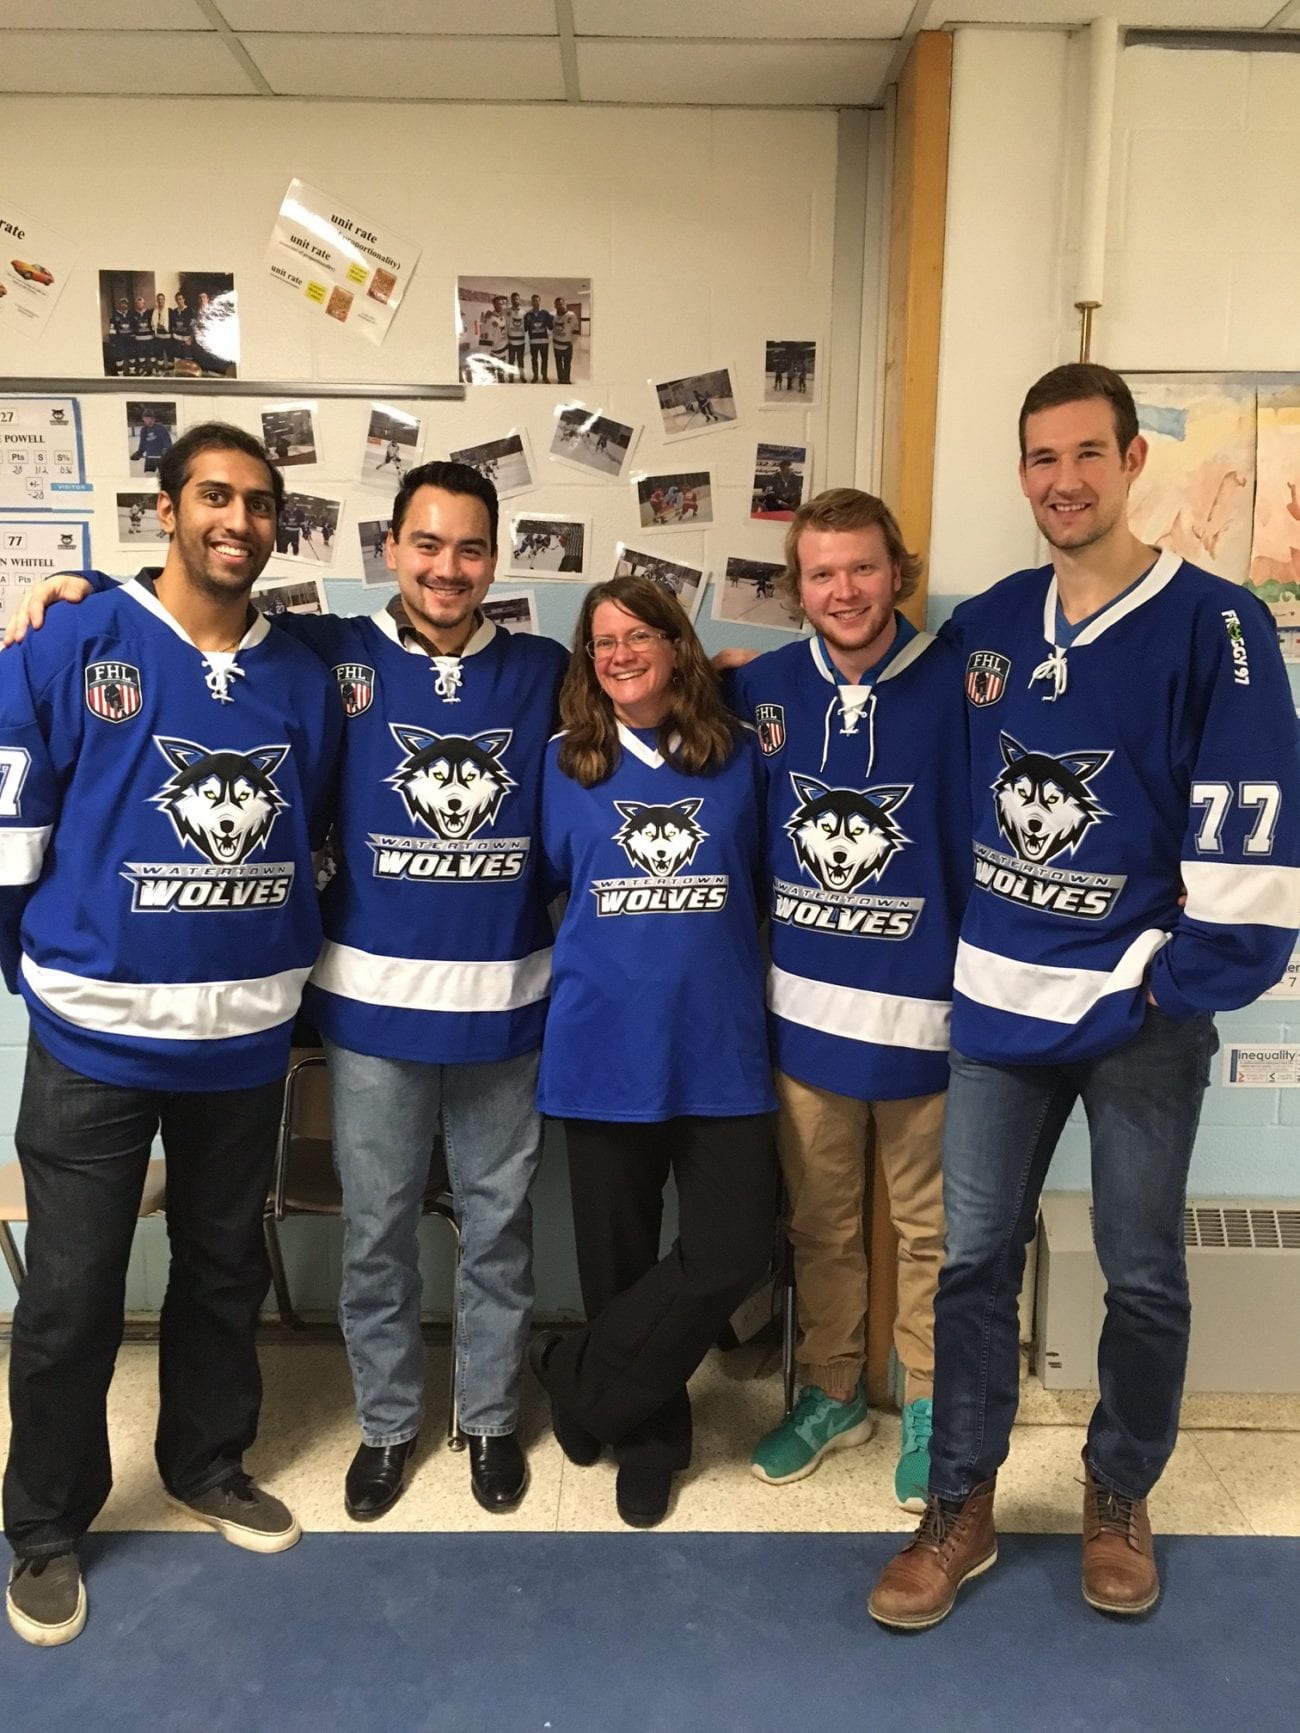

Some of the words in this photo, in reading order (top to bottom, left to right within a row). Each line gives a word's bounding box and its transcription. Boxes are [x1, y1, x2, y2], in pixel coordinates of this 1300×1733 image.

[331, 214, 353, 231] unit
[356, 227, 378, 244] rate
[290, 234, 309, 249] unit
[312, 244, 332, 261] rate
[271, 265, 287, 278] unit
[288, 272, 303, 285] rate
[0, 411, 14, 423] 27
[4, 434, 45, 443] POWELL
[11, 453, 25, 461] Pts
[38, 453, 44, 461] S
[8, 536, 22, 546] 77
[11, 558, 55, 567] WHITELL
[973, 654, 1001, 671] FHL
[94, 664, 131, 682] FHL
[337, 666, 366, 680] FHL
[1190, 781, 1282, 856] 77
[380, 837, 521, 849] WATERTOWN
[142, 866, 287, 876] WATERTOWN
[378, 849, 524, 878] WOLVES
[976, 844, 1110, 886] WATERTOWN
[600, 877, 724, 887] WATERTOWN
[974, 858, 1112, 915] WOLVES
[139, 878, 289, 906] WOLVES
[601, 887, 727, 913] WOLVES
[777, 882, 910, 908] WATERTOWN
[774, 894, 914, 935] WOLVES
[1238, 1049, 1296, 1062] inequality
